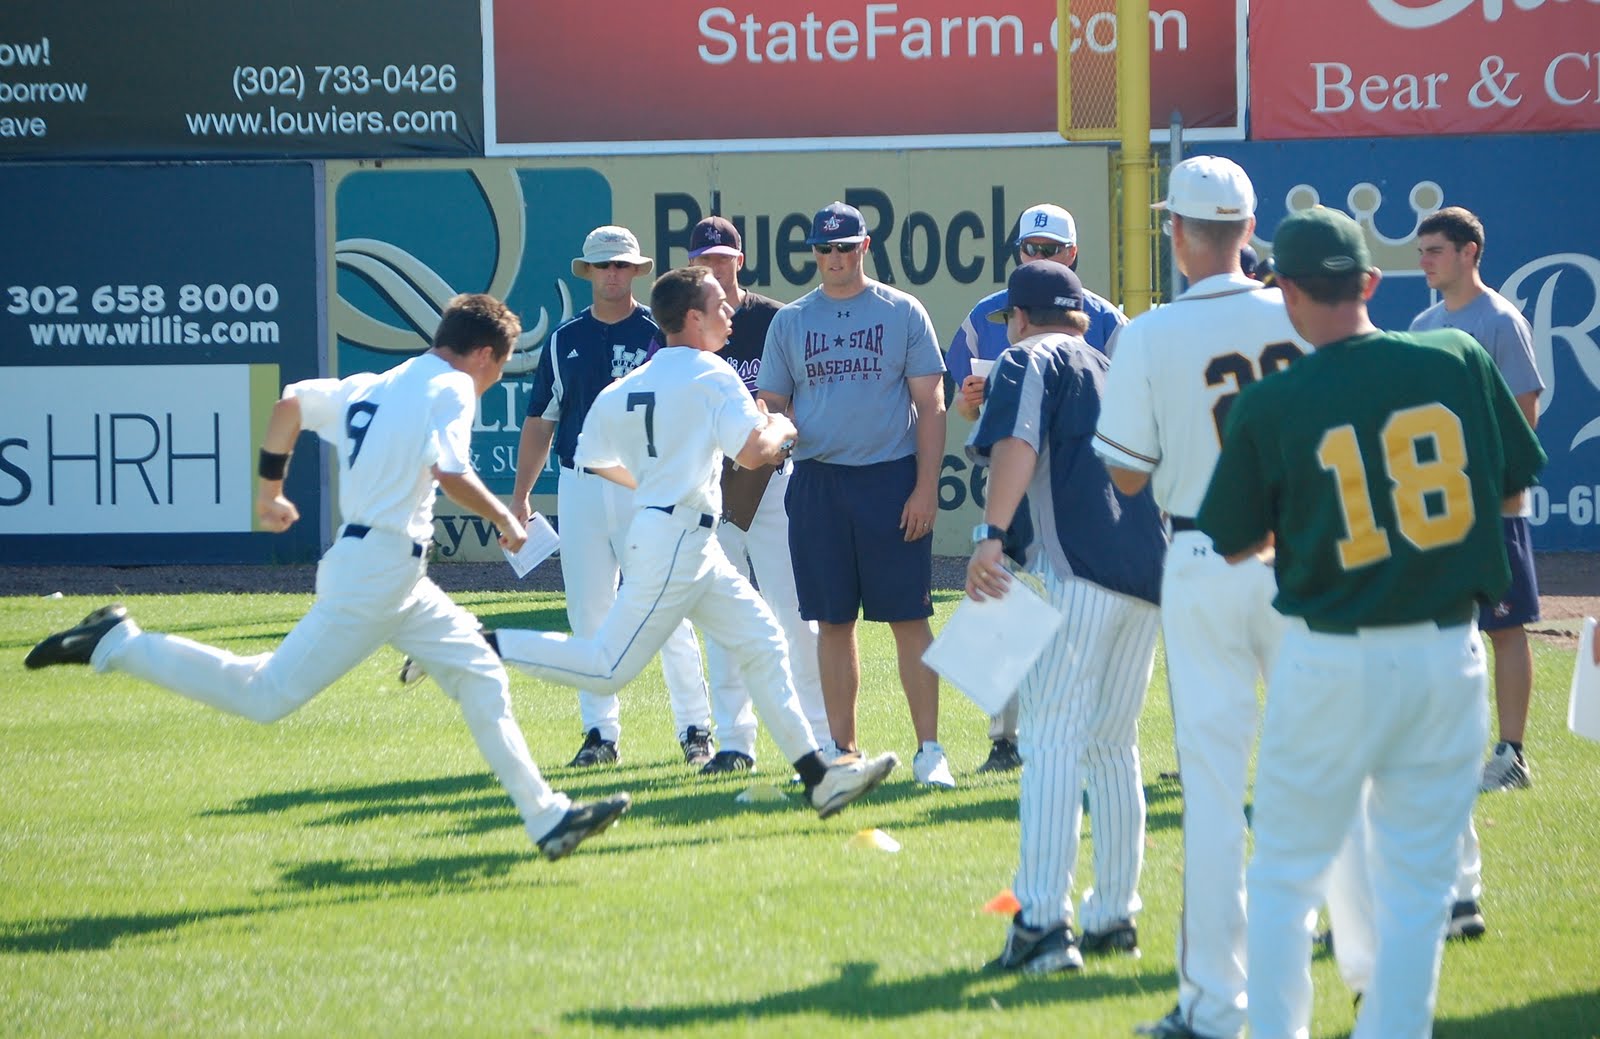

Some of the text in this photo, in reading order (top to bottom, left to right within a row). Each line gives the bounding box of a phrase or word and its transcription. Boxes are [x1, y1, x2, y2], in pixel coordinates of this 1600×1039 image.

[698, 3, 1188, 64] StateFarm.com
[232, 65, 457, 100] (302) 733-0426
[1310, 51, 1600, 114] Bear & C
[185, 106, 458, 137] www.louviers.com
[7, 283, 280, 315] 302 658 8000
[30, 314, 280, 346] www.willis.com
[805, 323, 884, 361] ALL STAR
[805, 356, 882, 378] BASEBALL
[809, 373, 882, 387] ACADEMY
[346, 401, 380, 469] 9
[626, 391, 658, 458] 7
[1316, 402, 1476, 571] 18
